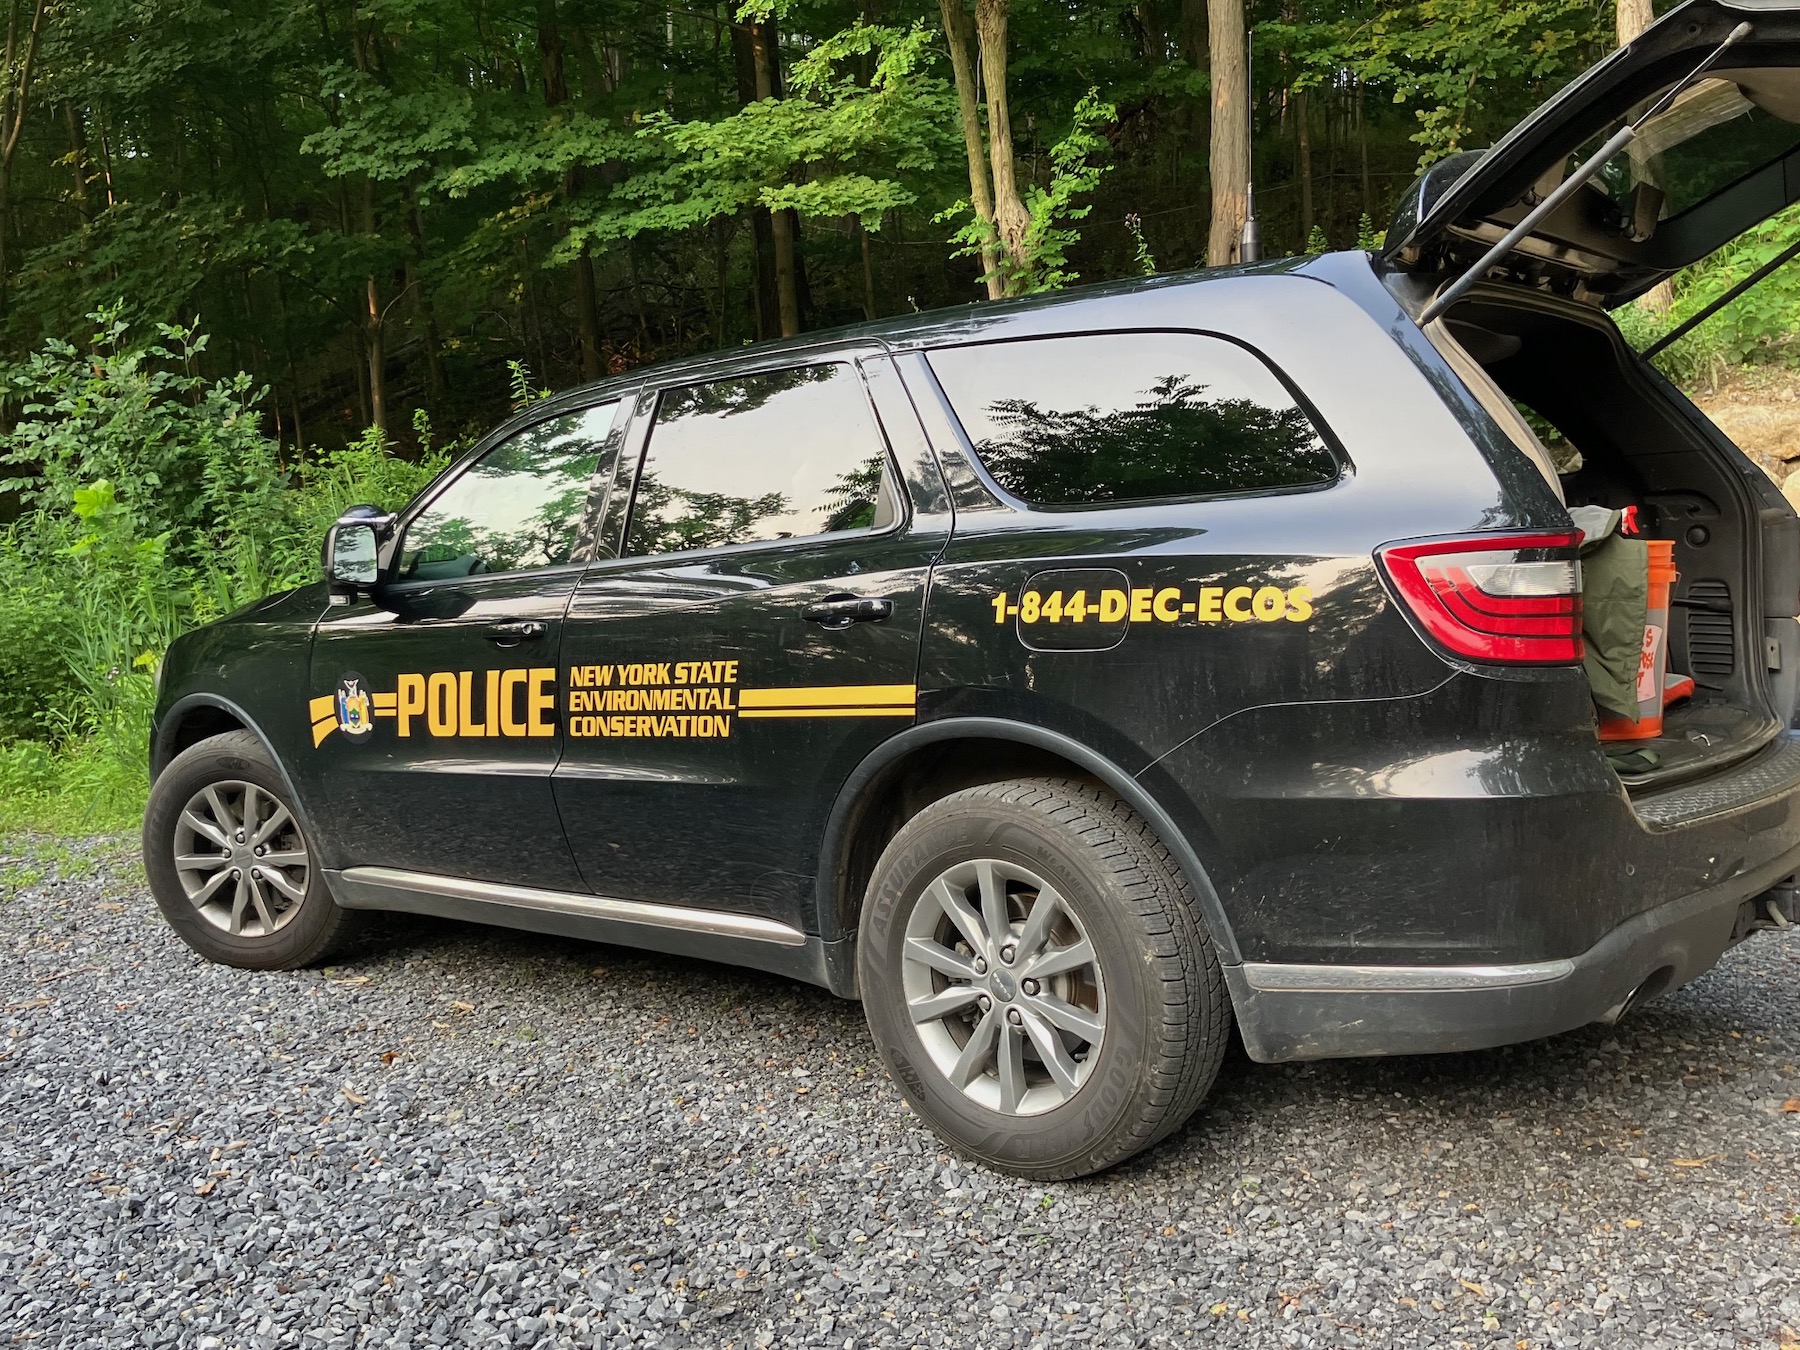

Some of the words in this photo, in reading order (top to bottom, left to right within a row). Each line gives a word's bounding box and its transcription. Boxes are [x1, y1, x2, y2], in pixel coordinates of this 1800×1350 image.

[992, 586, 1314, 623] 1-844-DEC-ECOS
[570, 666, 616, 688] NEW
[617, 663, 671, 686] YORK
[674, 660, 739, 685] STATE
[397, 667, 556, 737] POLICE
[569, 687, 737, 712] ENVIRONMENTAL
[569, 715, 731, 738] CONSERVATION
